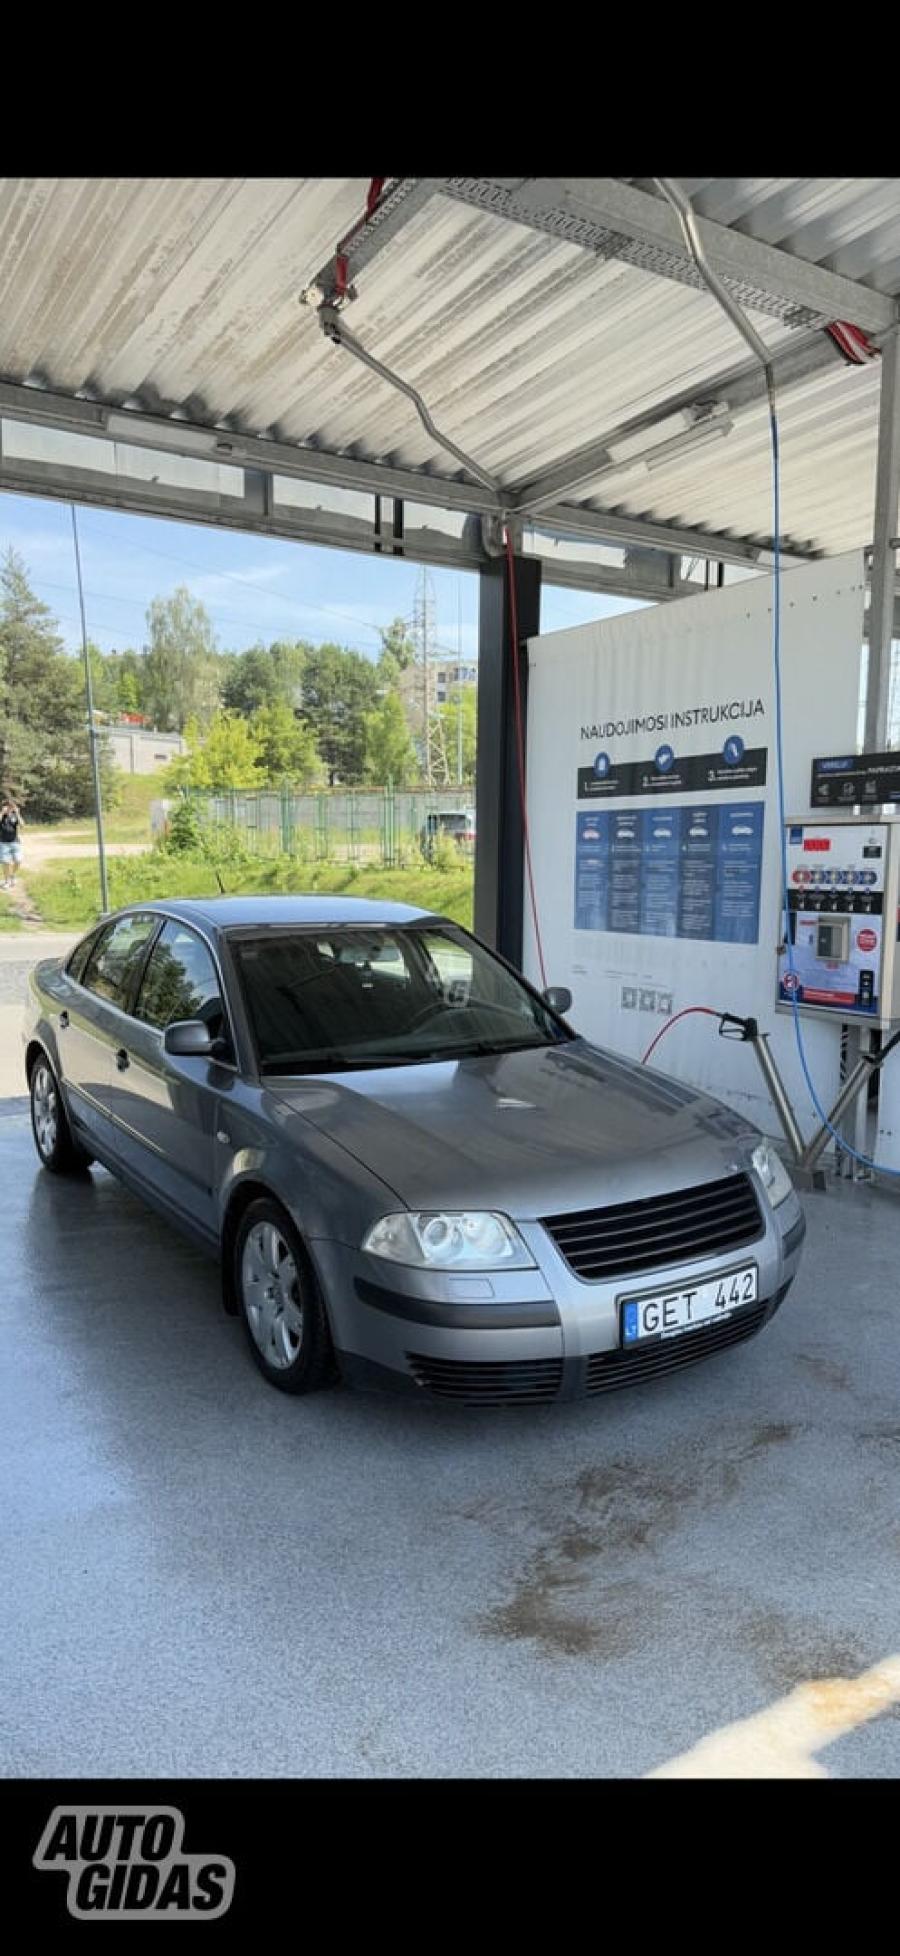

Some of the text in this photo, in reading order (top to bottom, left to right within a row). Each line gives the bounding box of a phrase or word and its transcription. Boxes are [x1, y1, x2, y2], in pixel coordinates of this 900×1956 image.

[580, 698, 765, 739] NAUDOJIMOSI INSTRUKCIJA
[643, 1292, 697, 1332] GET
[714, 1273, 754, 1309] 442
